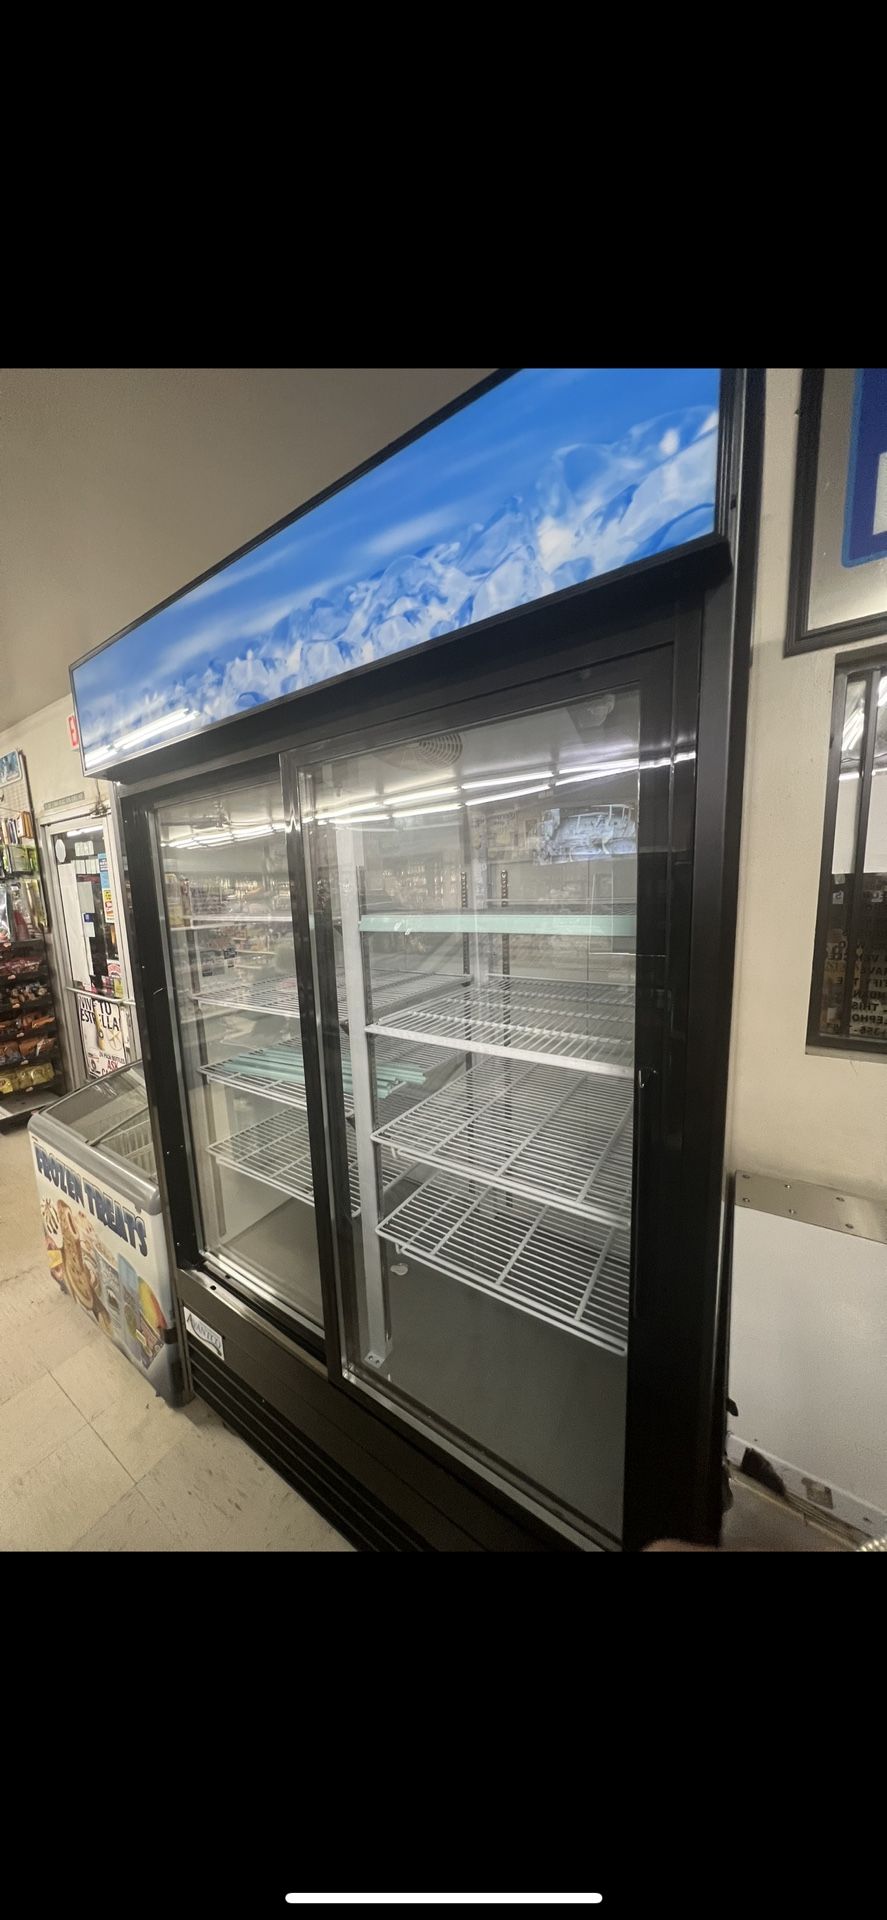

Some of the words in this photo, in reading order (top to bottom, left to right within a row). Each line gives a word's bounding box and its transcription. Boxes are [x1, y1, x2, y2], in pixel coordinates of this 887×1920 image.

[80, 1008, 120, 1032] ESTRLLA
[35, 1142, 84, 1208] FROZEN
[82, 1177, 148, 1257] TREATS
